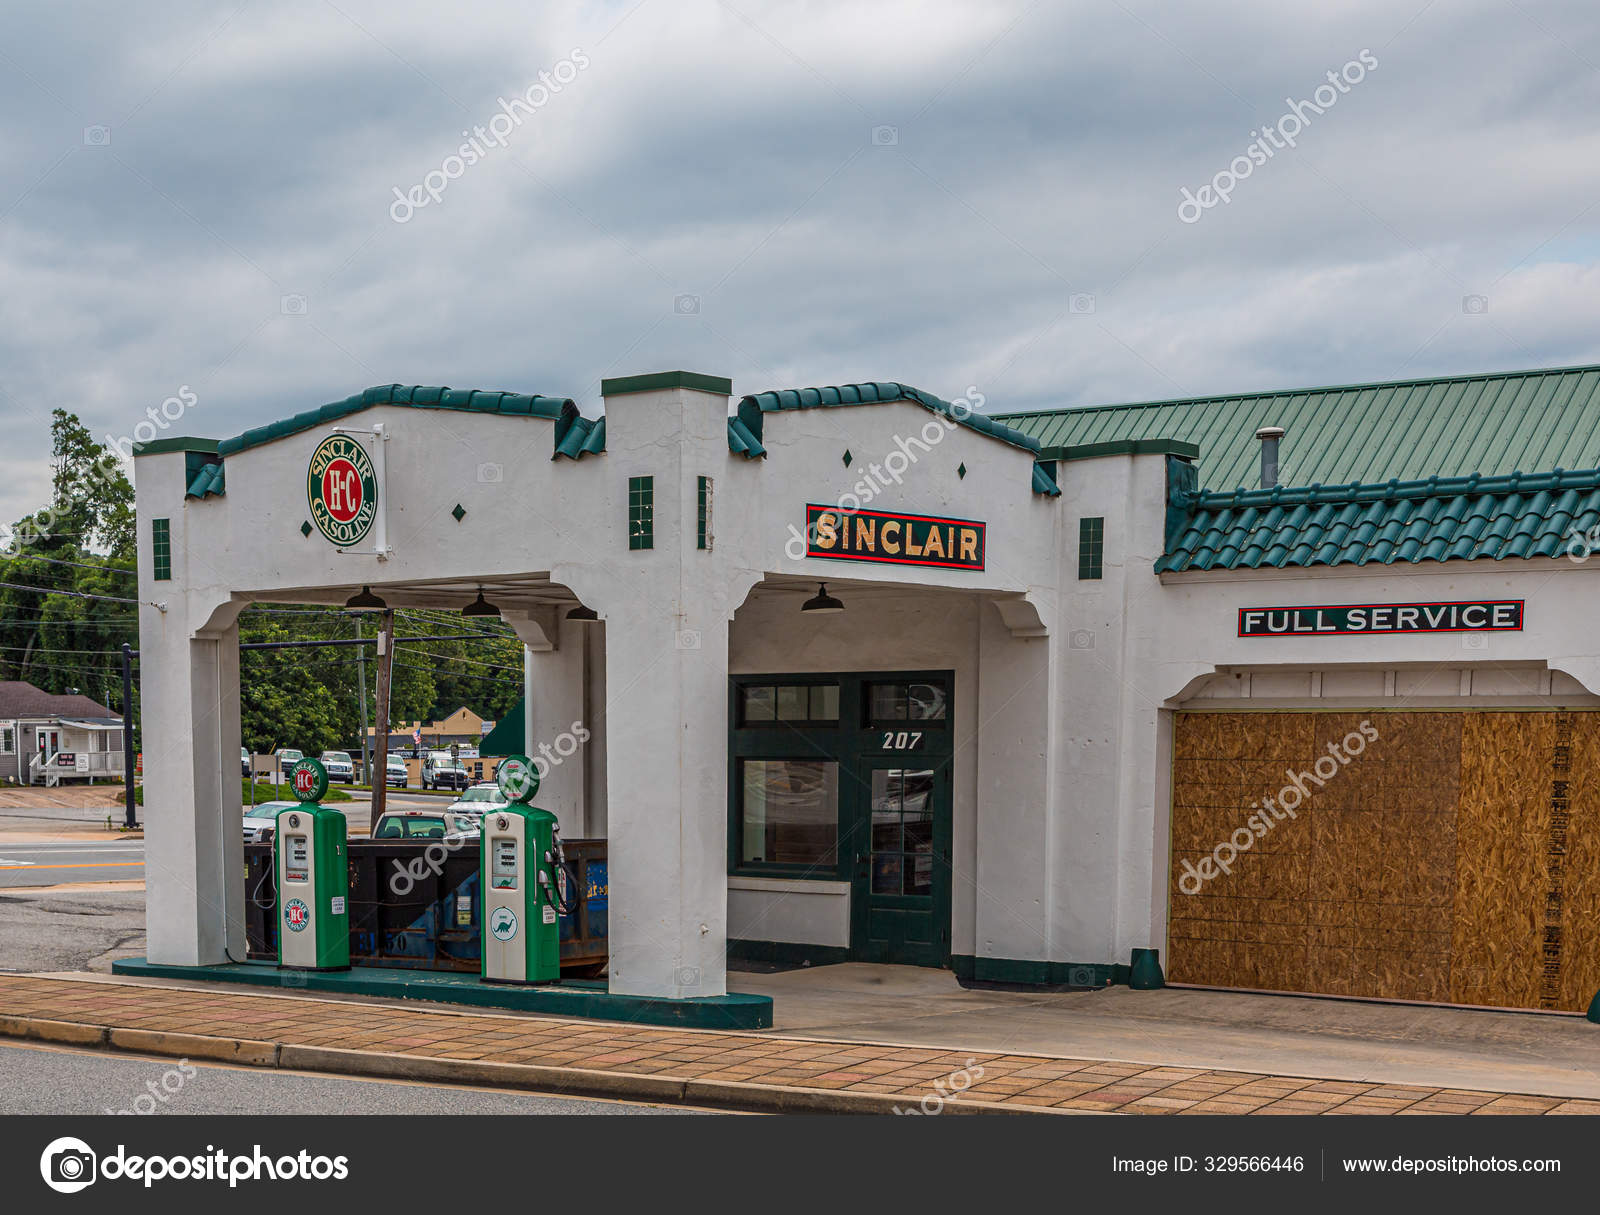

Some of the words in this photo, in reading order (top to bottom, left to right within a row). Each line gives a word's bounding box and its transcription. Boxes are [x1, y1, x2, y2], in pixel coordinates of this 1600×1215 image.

[313, 441, 371, 480] SINCLAIR
[313, 498, 373, 540] GASOLINE
[816, 514, 977, 560] SINCLAIR
[1245, 610, 1336, 633] FULL
[1346, 605, 1515, 630] SERVICE
[882, 732, 922, 750] 207
[297, 774, 312, 789] HC
